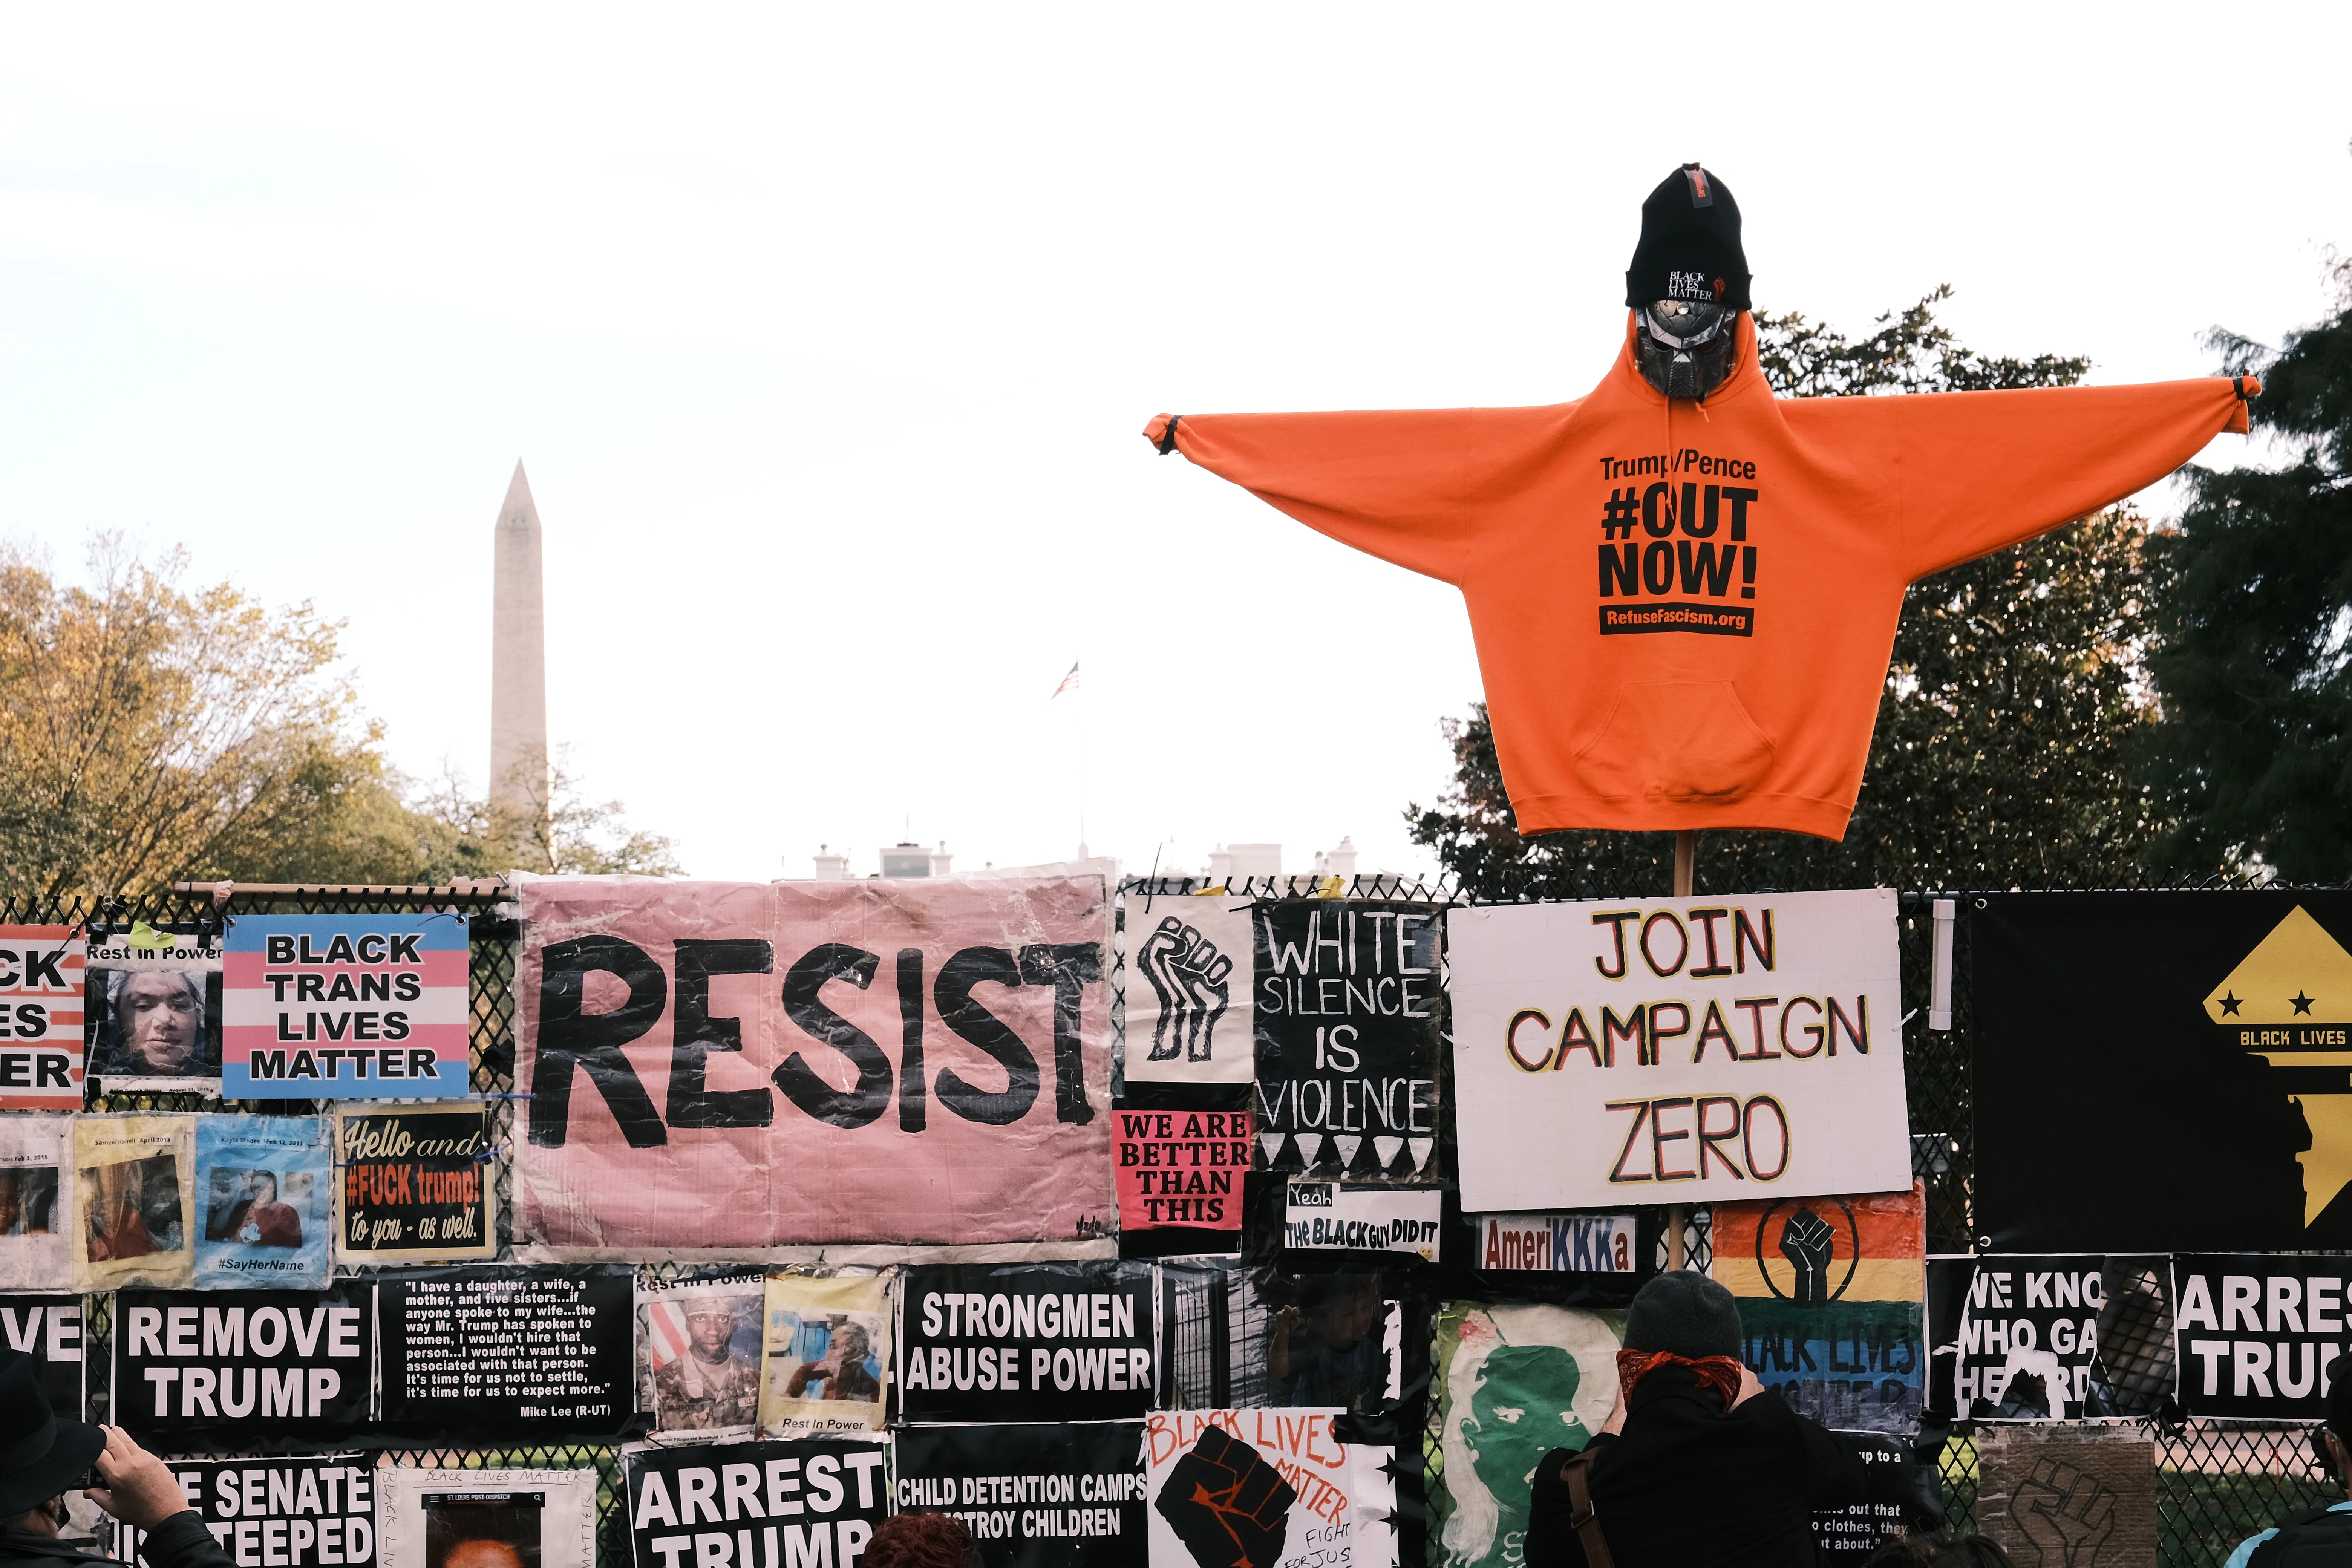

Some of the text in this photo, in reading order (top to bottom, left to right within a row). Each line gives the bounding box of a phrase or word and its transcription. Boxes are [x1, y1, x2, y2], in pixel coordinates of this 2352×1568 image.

[1669, 271, 1705, 282] BLACK
[1669, 279, 1699, 289] LIVES
[1668, 288, 1712, 300] MATTER
[1600, 449, 1756, 480] Trump/Pence
[1601, 482, 1758, 541] #OUT
[1598, 540, 1757, 599] NOW!
[1607, 609, 1746, 630] RefuseFascism.org
[87, 947, 131, 960] Rest
[162, 947, 222, 960] Power
[268, 935, 422, 964] BLACK
[1262, 909, 1431, 976] WHITE
[1590, 907, 1775, 979] JOIN
[266, 973, 421, 1001] TRANS
[1258, 976, 1430, 1018] SILENCE
[279, 1011, 409, 1040] LIVES
[1506, 994, 1870, 1073] CAMPAIGN
[2240, 1030, 2346, 1046] BLACK LIVES
[528, 934, 1104, 1149] RESIST
[1315, 1024, 1359, 1073] IS
[251, 1049, 438, 1078] MATTER
[1254, 1077, 1434, 1132] VIOLENCE
[345, 1119, 481, 1160] Hello and
[1121, 1114, 1247, 1139] WE ARE
[1605, 1093, 1791, 1184] ZERO
[1119, 1141, 1250, 1167] BETTER
[347, 1162, 479, 1213] #FUCK trump!
[1136, 1170, 1232, 1195] THAN
[1290, 1184, 1331, 1205] Yeah
[1144, 1198, 1224, 1222] THIS
[351, 1207, 477, 1250] to you as well.
[1312, 1217, 1438, 1249] BLACK GUY DID IT
[1485, 1218, 1629, 1271] AmeriKKKa
[218, 1258, 304, 1271] #SayHerName
[405, 1278, 586, 1294] "I have a daughter, a wife, a
[406, 1291, 579, 1307] mother, and five sisters...if
[406, 1304, 596, 1321] anyone spoke to my wife...the
[922, 1292, 1135, 1338] STRONGMEN
[2177, 1275, 2352, 1332] ARRE
[0, 1306, 82, 1362] VE
[128, 1307, 360, 1357] REMOVE
[406, 1318, 591, 1334] way Mr. Trump has spoken to
[406, 1331, 581, 1346] women, I wouldn't hire that
[406, 1344, 596, 1361] person...I wouldn't want to be
[1742, 1321, 1916, 1375] LACK LIVES
[406, 1358, 588, 1372] associated with that person.
[407, 1370, 588, 1385] It's time for us not to settle,
[906, 1346, 1152, 1392] ABUSE POWER
[144, 1367, 341, 1418] TRUMP
[407, 1383, 610, 1398] it's time for us to expect more."
[521, 1404, 610, 1418] Mike Lee (R-UT)
[782, 1418, 865, 1430] Rest In Power
[1147, 1410, 1346, 1469] BLACK LIVES
[1877, 1449, 1901, 1463] to a
[425, 1470, 588, 1484] BLACK LIVES MATTER
[634, 1451, 883, 1530] ARREST
[898, 1473, 1148, 1507] CHILD DETENTION CAMPS
[215, 1467, 371, 1518] SENATE
[382, 1471, 397, 1528] BLACK
[1275, 1458, 1348, 1527] MATTER
[1022, 1508, 1121, 1539] CHILDREN
[1849, 1503, 1869, 1515] out
[1874, 1504, 1900, 1517] that
[1306, 1522, 1350, 1548] FIGHT
[1824, 1519, 1875, 1535] clothes,
[651, 1519, 873, 1568] TRUMP
[1284, 1556, 1310, 1568] FOR
